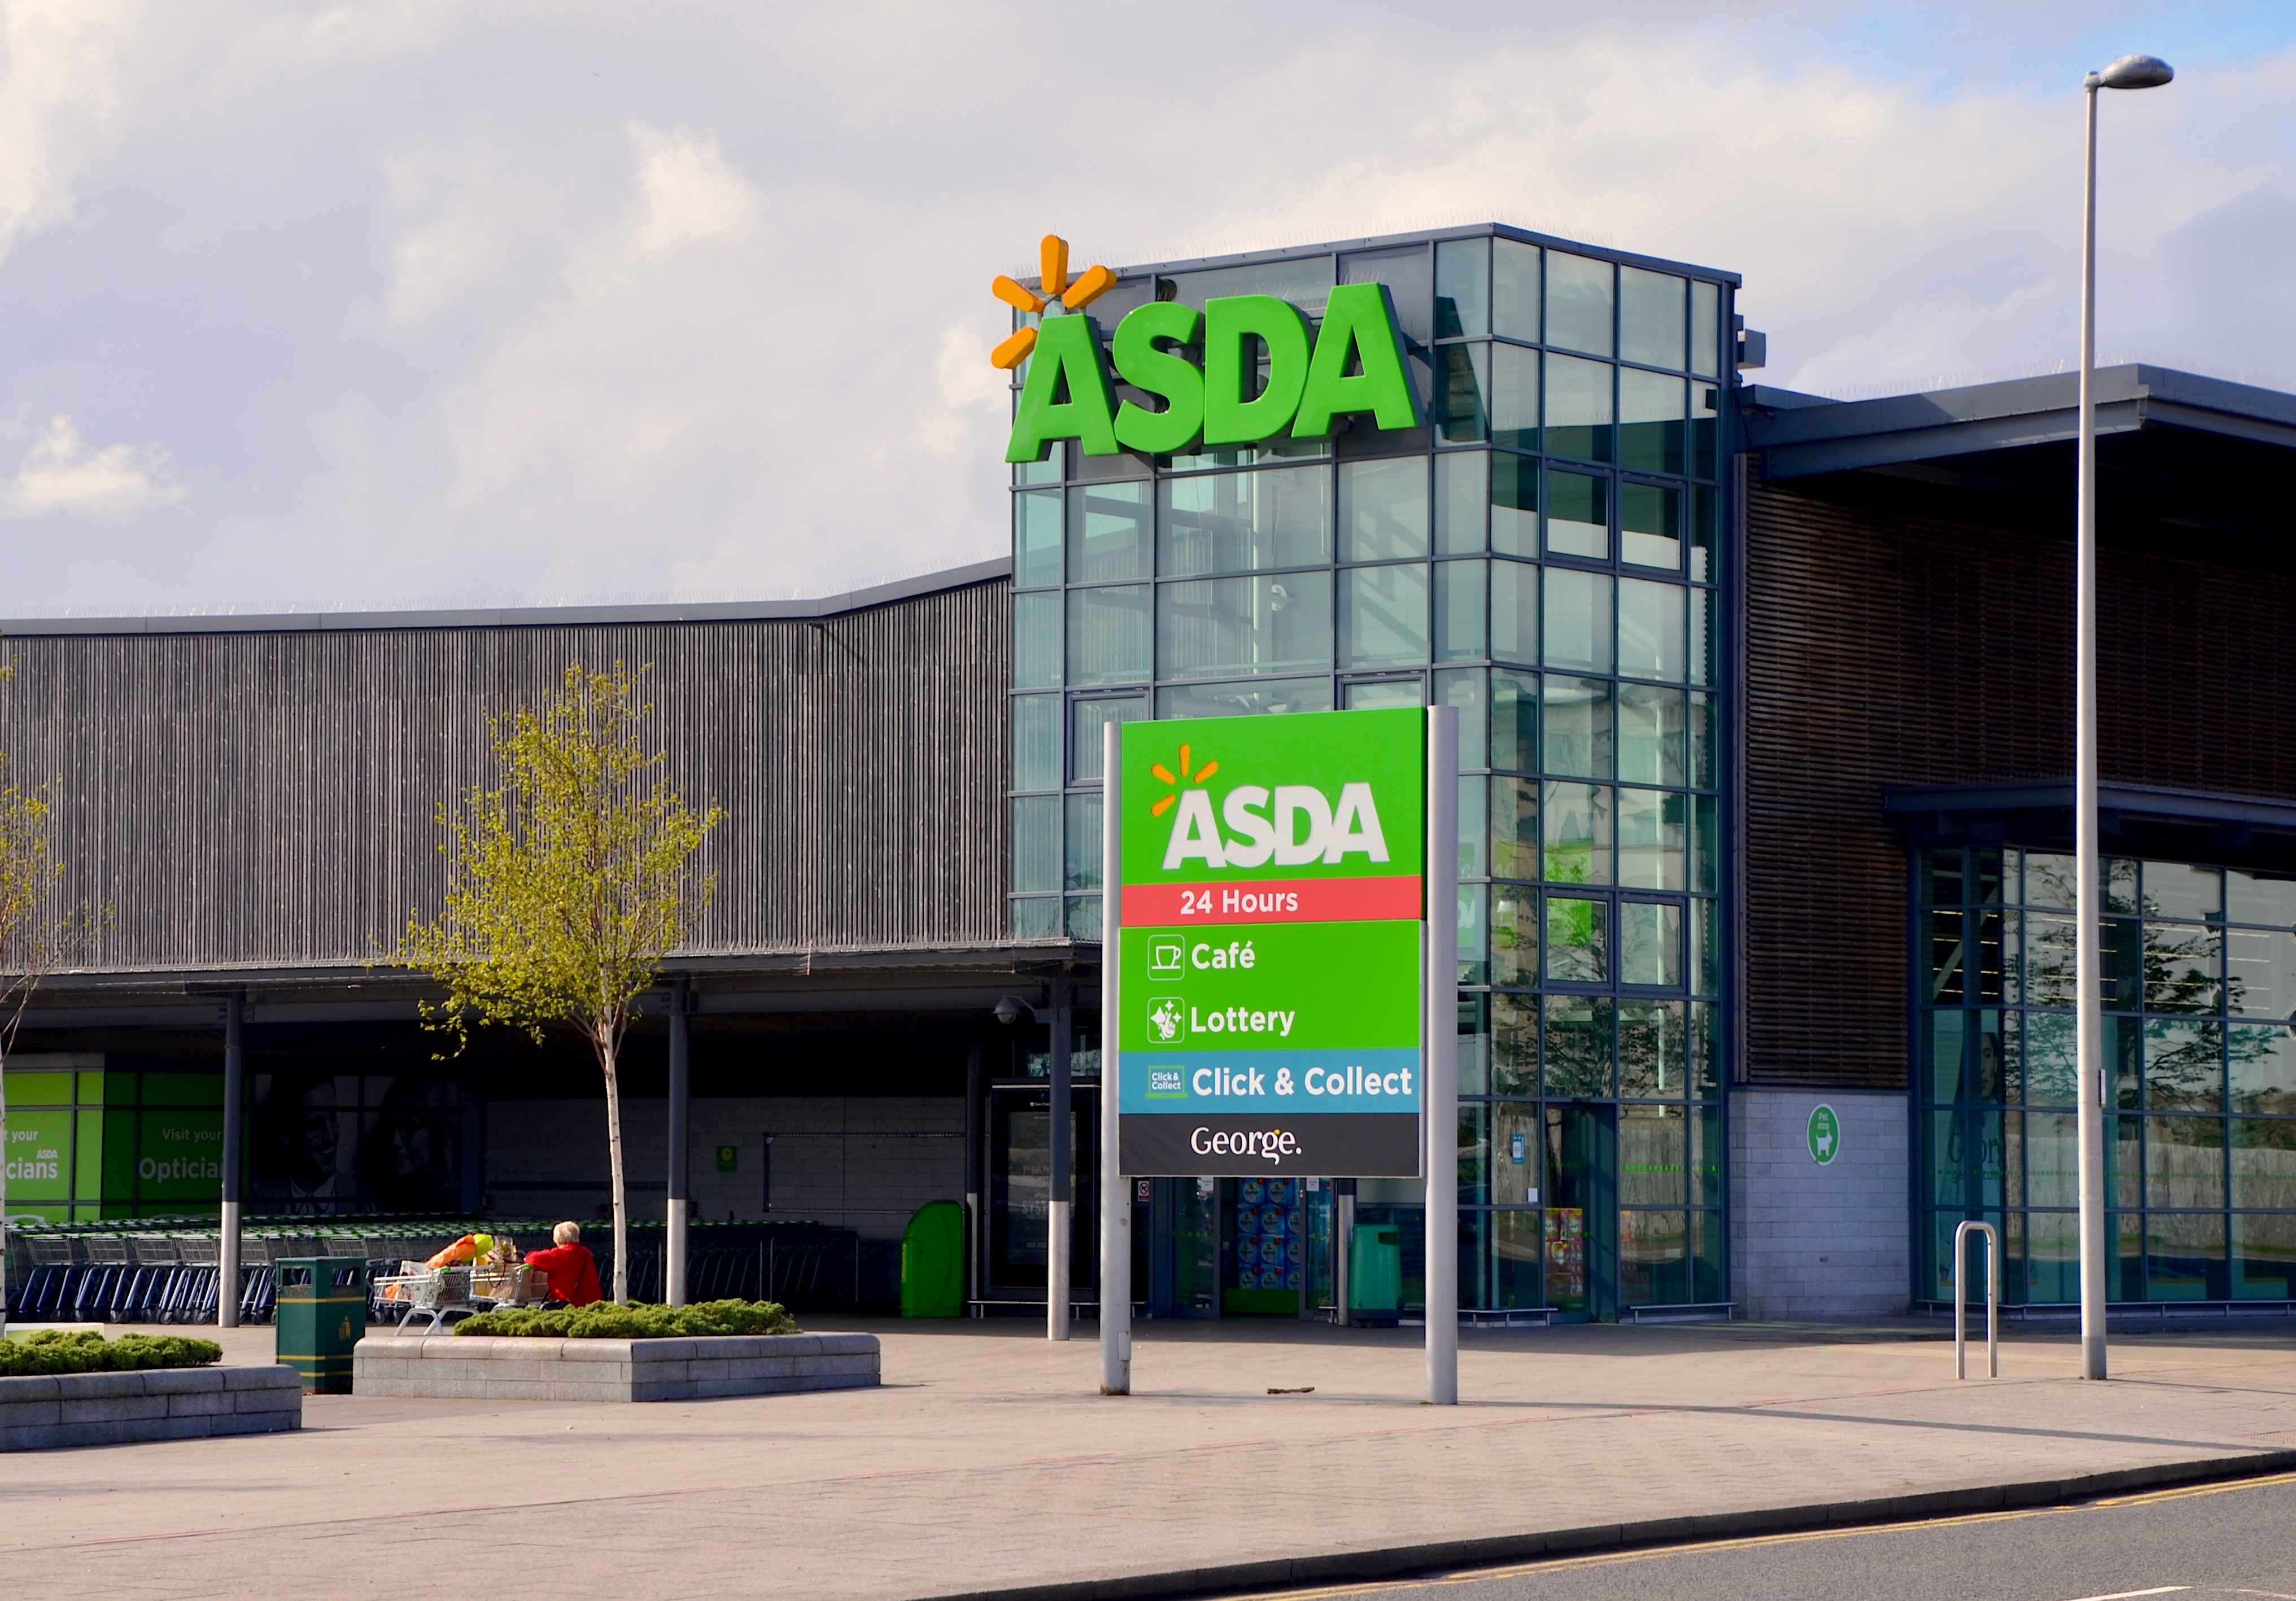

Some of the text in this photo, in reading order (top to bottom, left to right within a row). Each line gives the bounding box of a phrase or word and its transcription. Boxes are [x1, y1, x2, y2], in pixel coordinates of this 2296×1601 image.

[1005, 282, 1420, 463] ASDA
[1162, 782, 1390, 870] ASDA
[1180, 888, 1299, 915] 24 Hours
[1191, 941, 1256, 970] Café
[1191, 1007, 1295, 1036] Lottery
[1151, 1081, 1181, 1090] Collect
[1192, 1066, 1412, 1096] Click & Collect
[1817, 1122, 1830, 1131] stop
[1818, 1113, 1828, 1121] Pet
[12, 1131, 38, 1143] your
[162, 1128, 222, 1143] Visit your
[37, 1149, 58, 1159] ASDA
[6, 1157, 58, 1179] cians
[139, 1156, 223, 1184] Opticia
[1022, 1200, 1047, 1214] SYST
